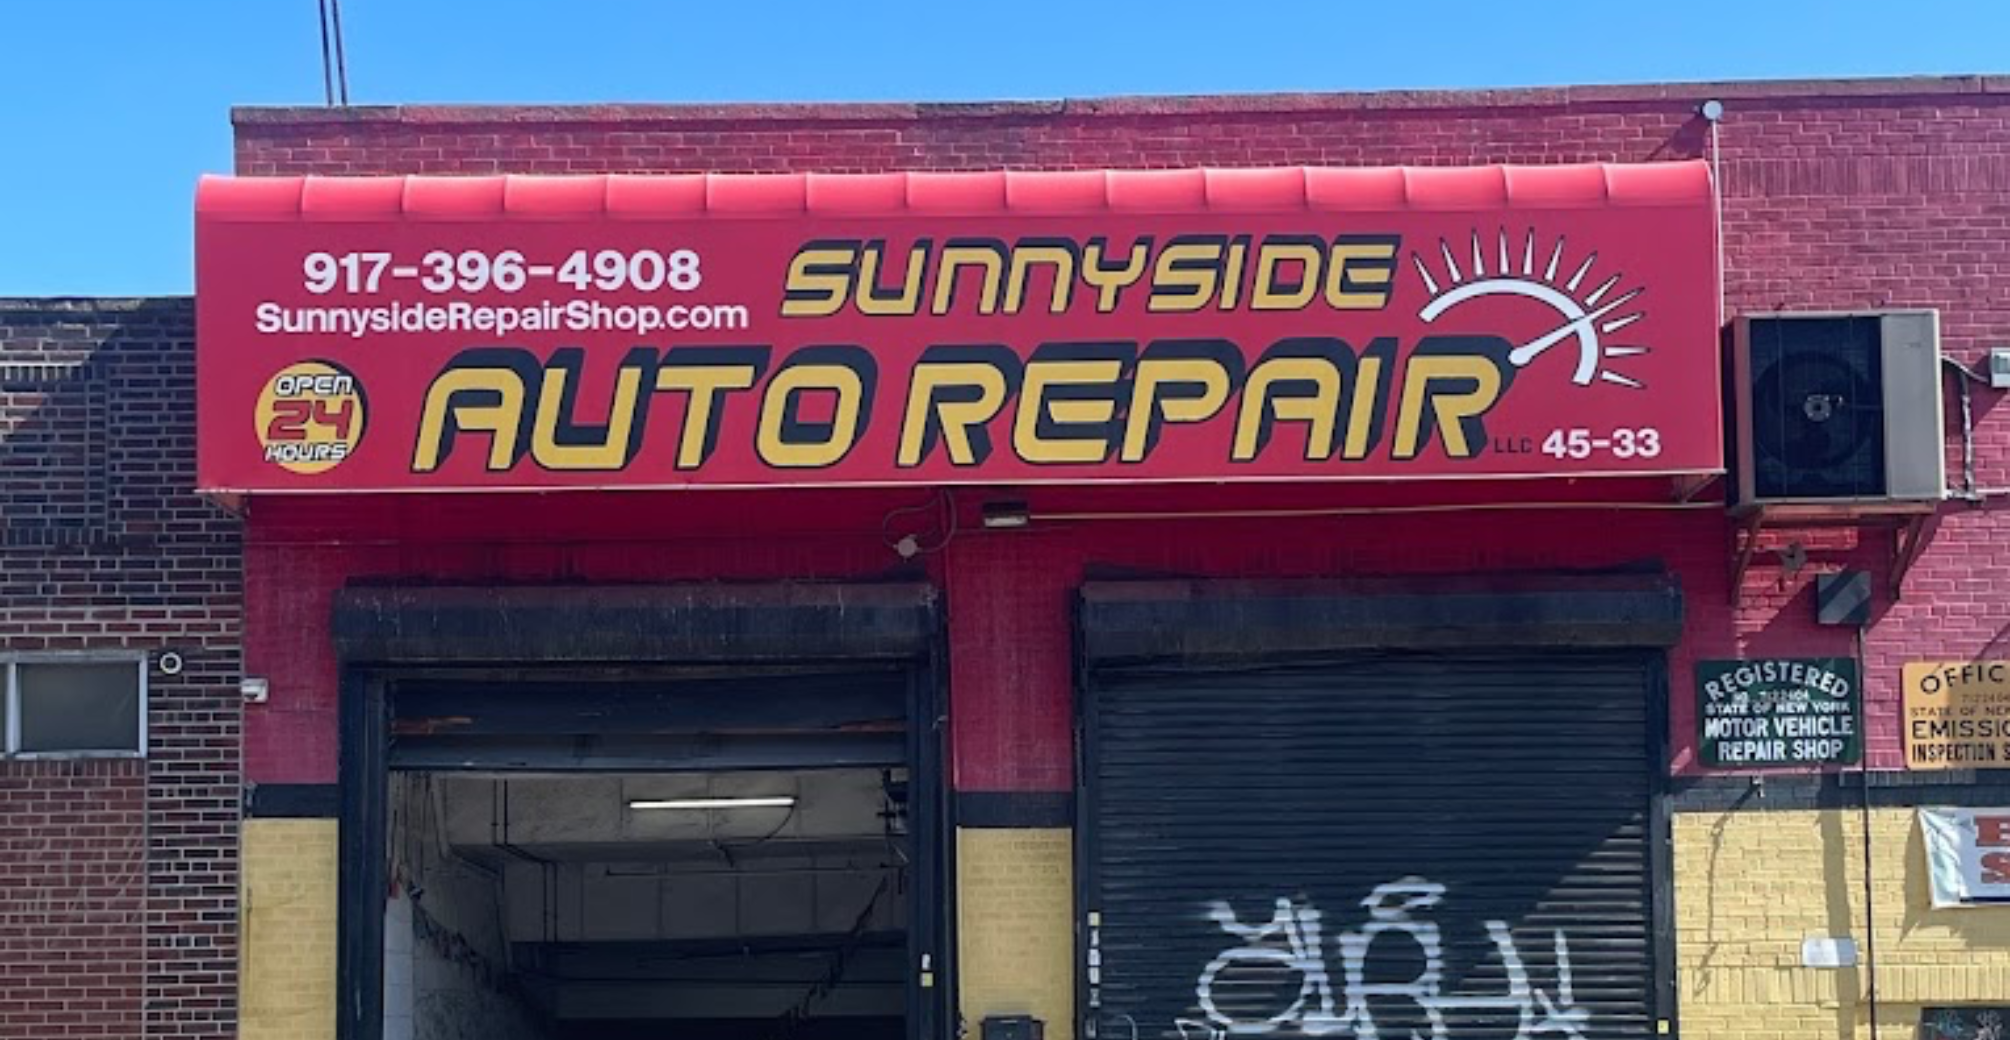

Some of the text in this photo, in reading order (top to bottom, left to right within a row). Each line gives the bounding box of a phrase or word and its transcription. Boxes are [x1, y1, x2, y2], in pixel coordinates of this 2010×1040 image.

[302, 249, 702, 294] 917-396-4908
[780, 233, 1402, 319] SUNNYSIDE
[255, 300, 749, 338] SunnysideRepairShop.com
[275, 374, 353, 397] OPEN
[411, 334, 1518, 473] AUTO REPAIR
[267, 399, 354, 441] 24
[264, 442, 349, 462] HOURS
[1494, 427, 1662, 460] LLC 45-33
[1705, 661, 1850, 701] REGISTERED
[1705, 700, 1852, 716] STATE OF NEW YORK
[1910, 706, 1952, 717] STATE
[1960, 705, 1977, 716] OF
[1704, 715, 1855, 738] MOTOR VEHICLE
[1717, 738, 1844, 762] REPAIR SHOP
[1911, 743, 1996, 763] INSPECTION
